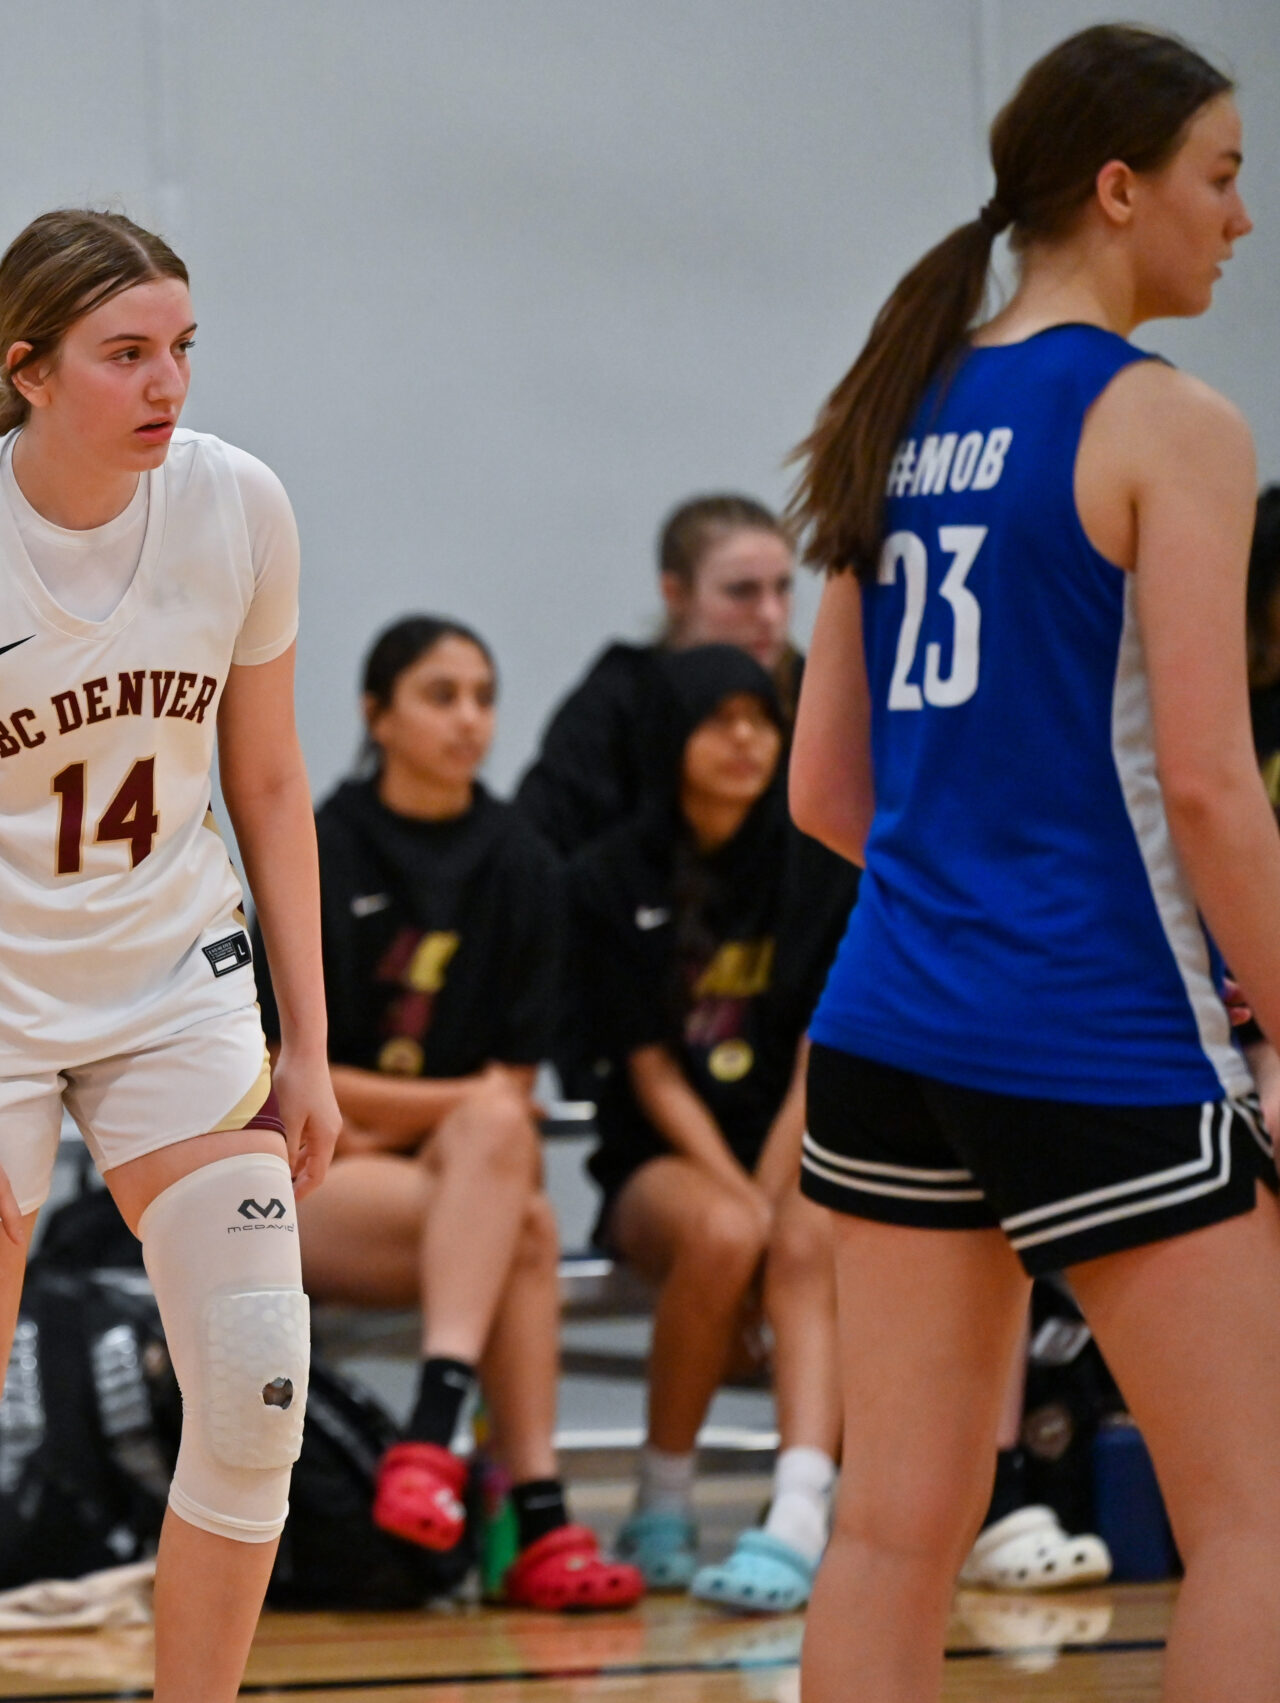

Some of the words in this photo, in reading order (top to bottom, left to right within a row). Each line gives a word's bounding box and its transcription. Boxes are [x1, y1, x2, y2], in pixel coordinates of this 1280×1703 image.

[884, 427, 1013, 497] #MOB
[878, 525, 988, 711] 23
[50, 670, 218, 736] DENVER
[50, 753, 160, 877] 14
